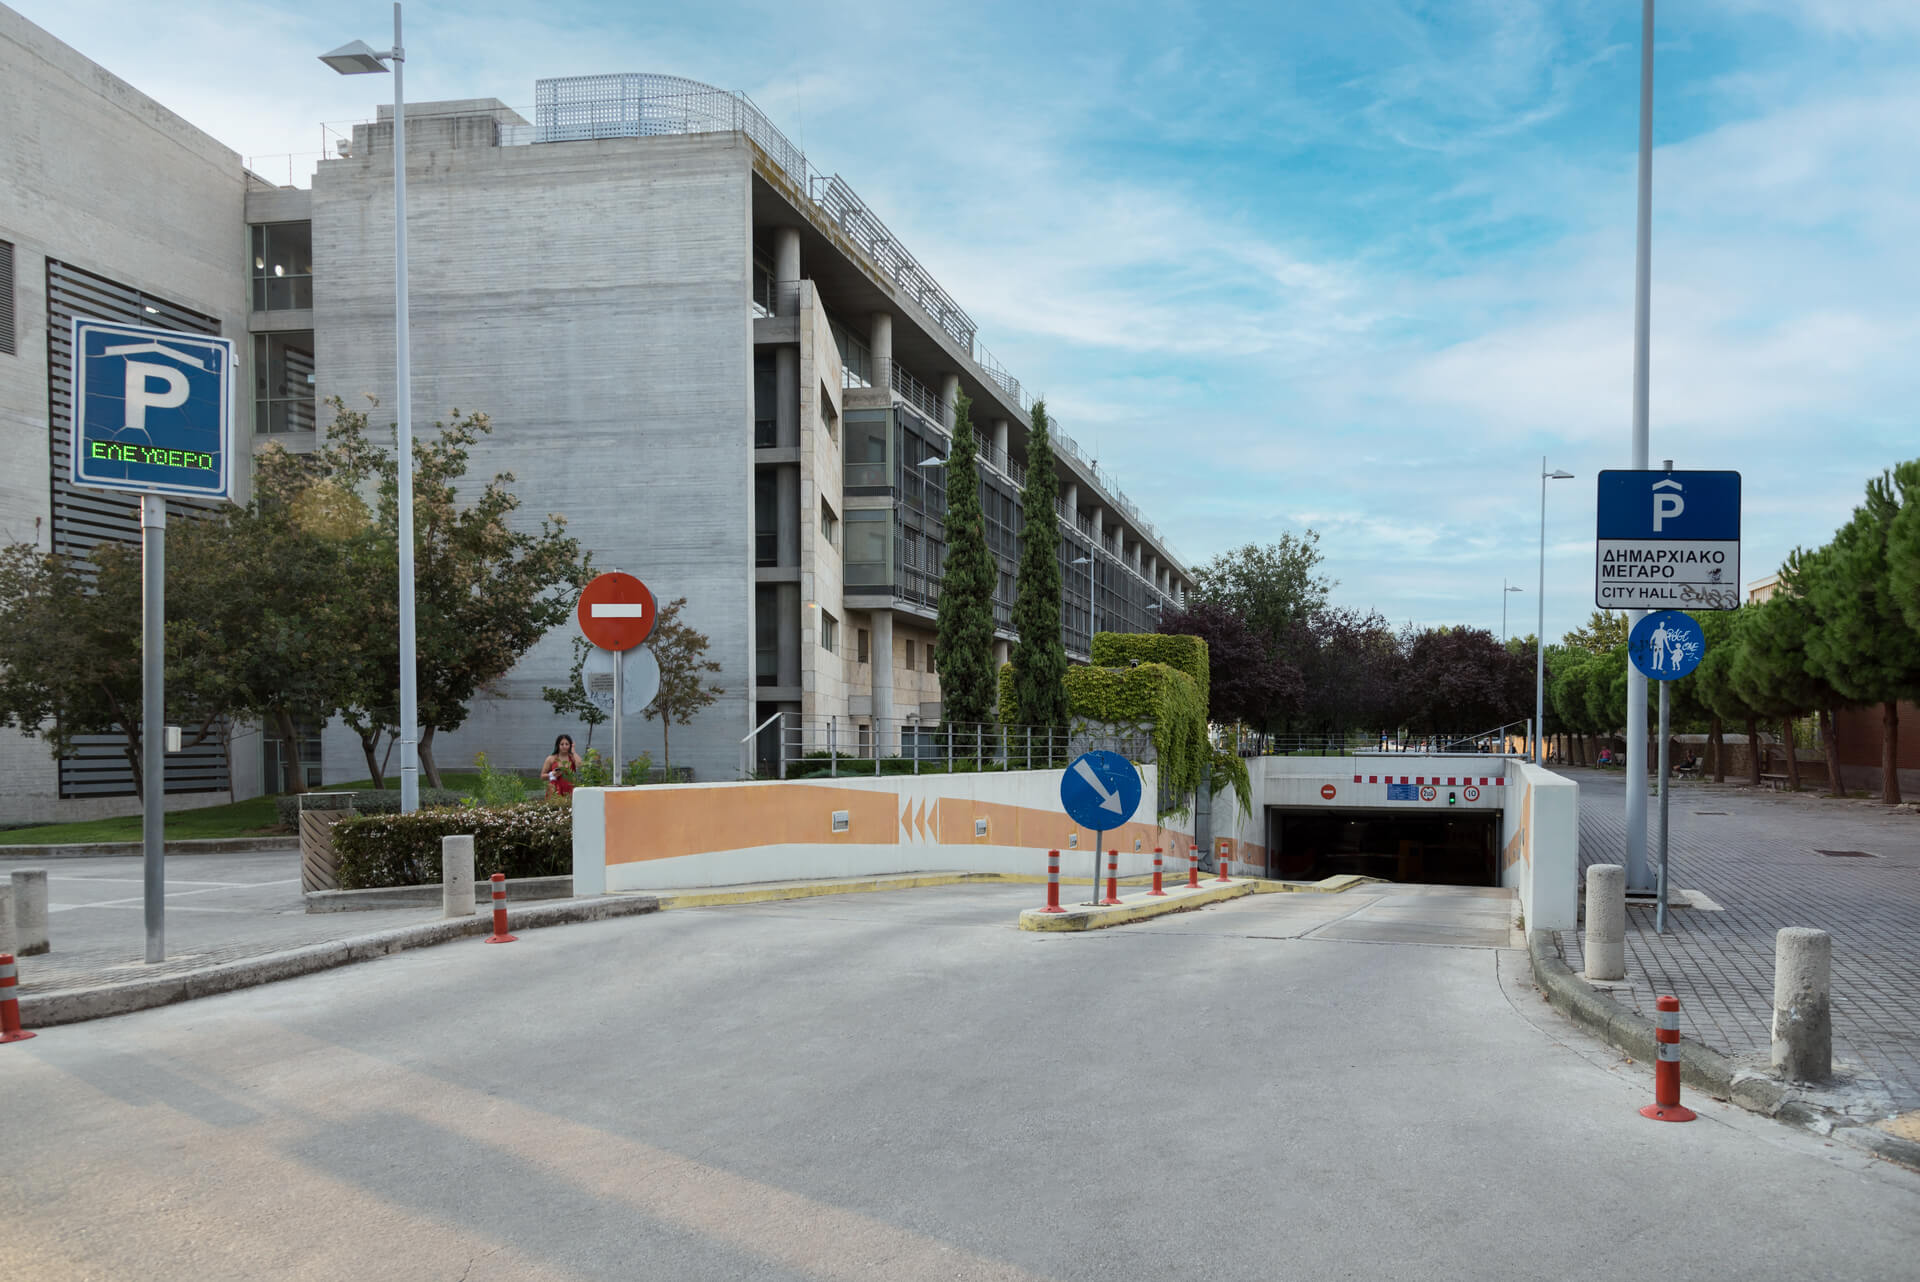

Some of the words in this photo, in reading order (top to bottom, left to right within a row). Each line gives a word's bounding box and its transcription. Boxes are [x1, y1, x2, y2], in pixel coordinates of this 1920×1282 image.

[125, 360, 190, 429] P
[1653, 493, 1685, 532] P
[1603, 549, 1725, 564] ΔΗΜΑΡΧΙΑΚΟ
[1602, 564, 1675, 578] ΜΕΓΑΡΟ
[1602, 587, 1635, 599] CITY
[1639, 587, 1678, 599] HALL
[1467, 789, 1477, 798] 10
